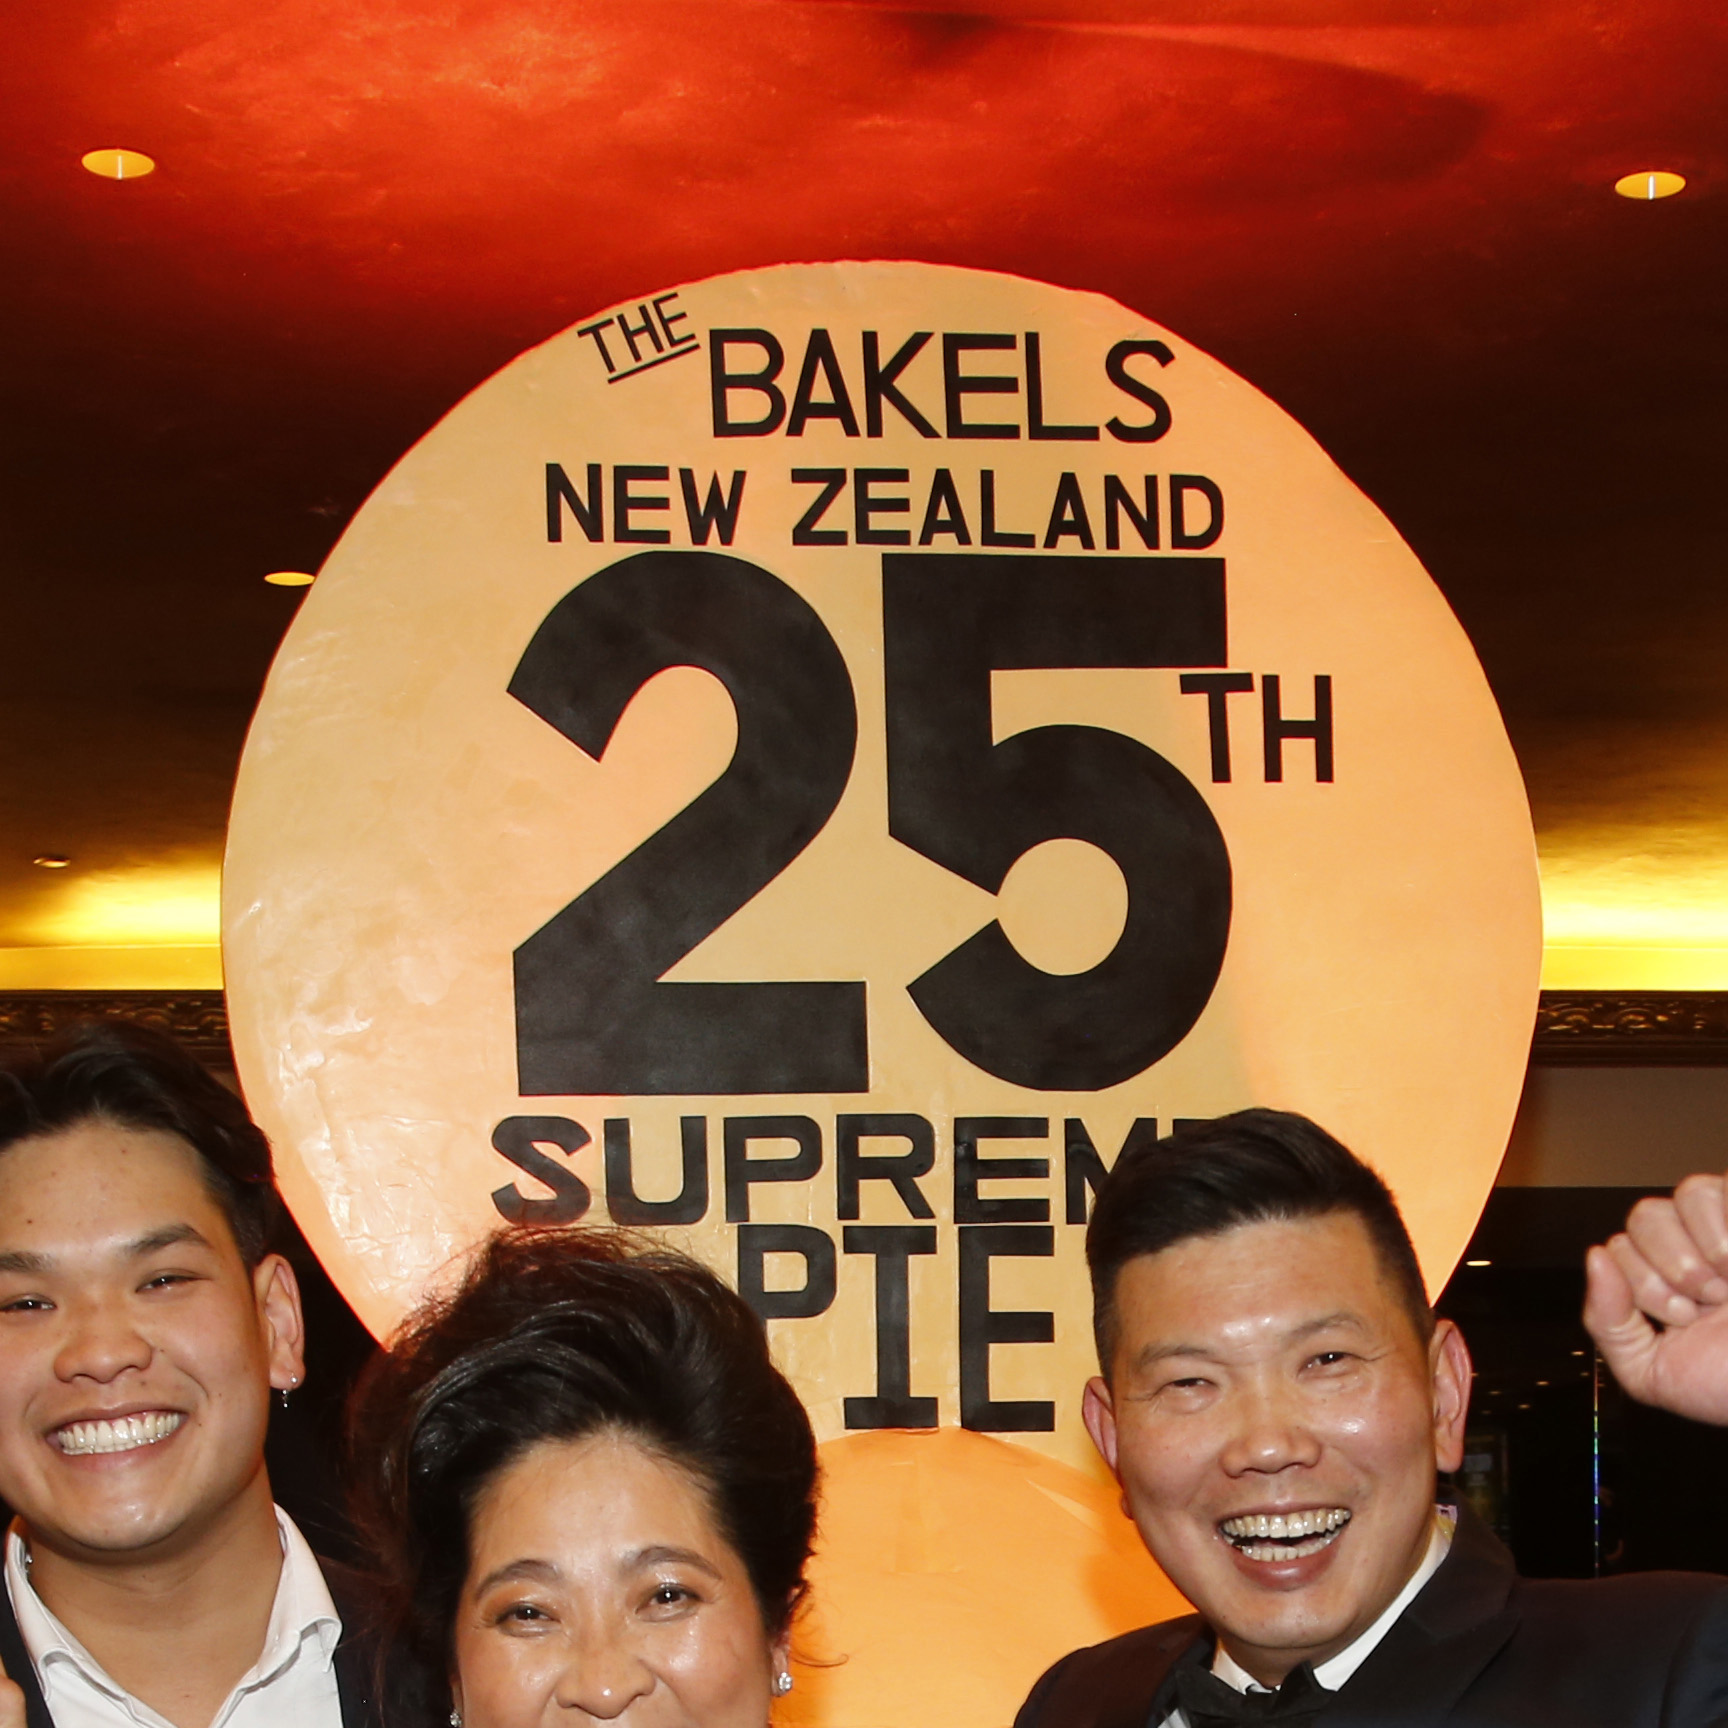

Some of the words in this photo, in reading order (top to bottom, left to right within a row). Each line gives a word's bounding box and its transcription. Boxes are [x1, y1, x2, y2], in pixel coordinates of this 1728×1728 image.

[577, 293, 698, 376] THE
[708, 328, 1175, 443] BAKELS
[545, 463, 747, 546] NEW
[790, 468, 1226, 551] ZEALAND
[491, 1113, 1218, 1226] SUPREM
[736, 1224, 1056, 1432] PIE
